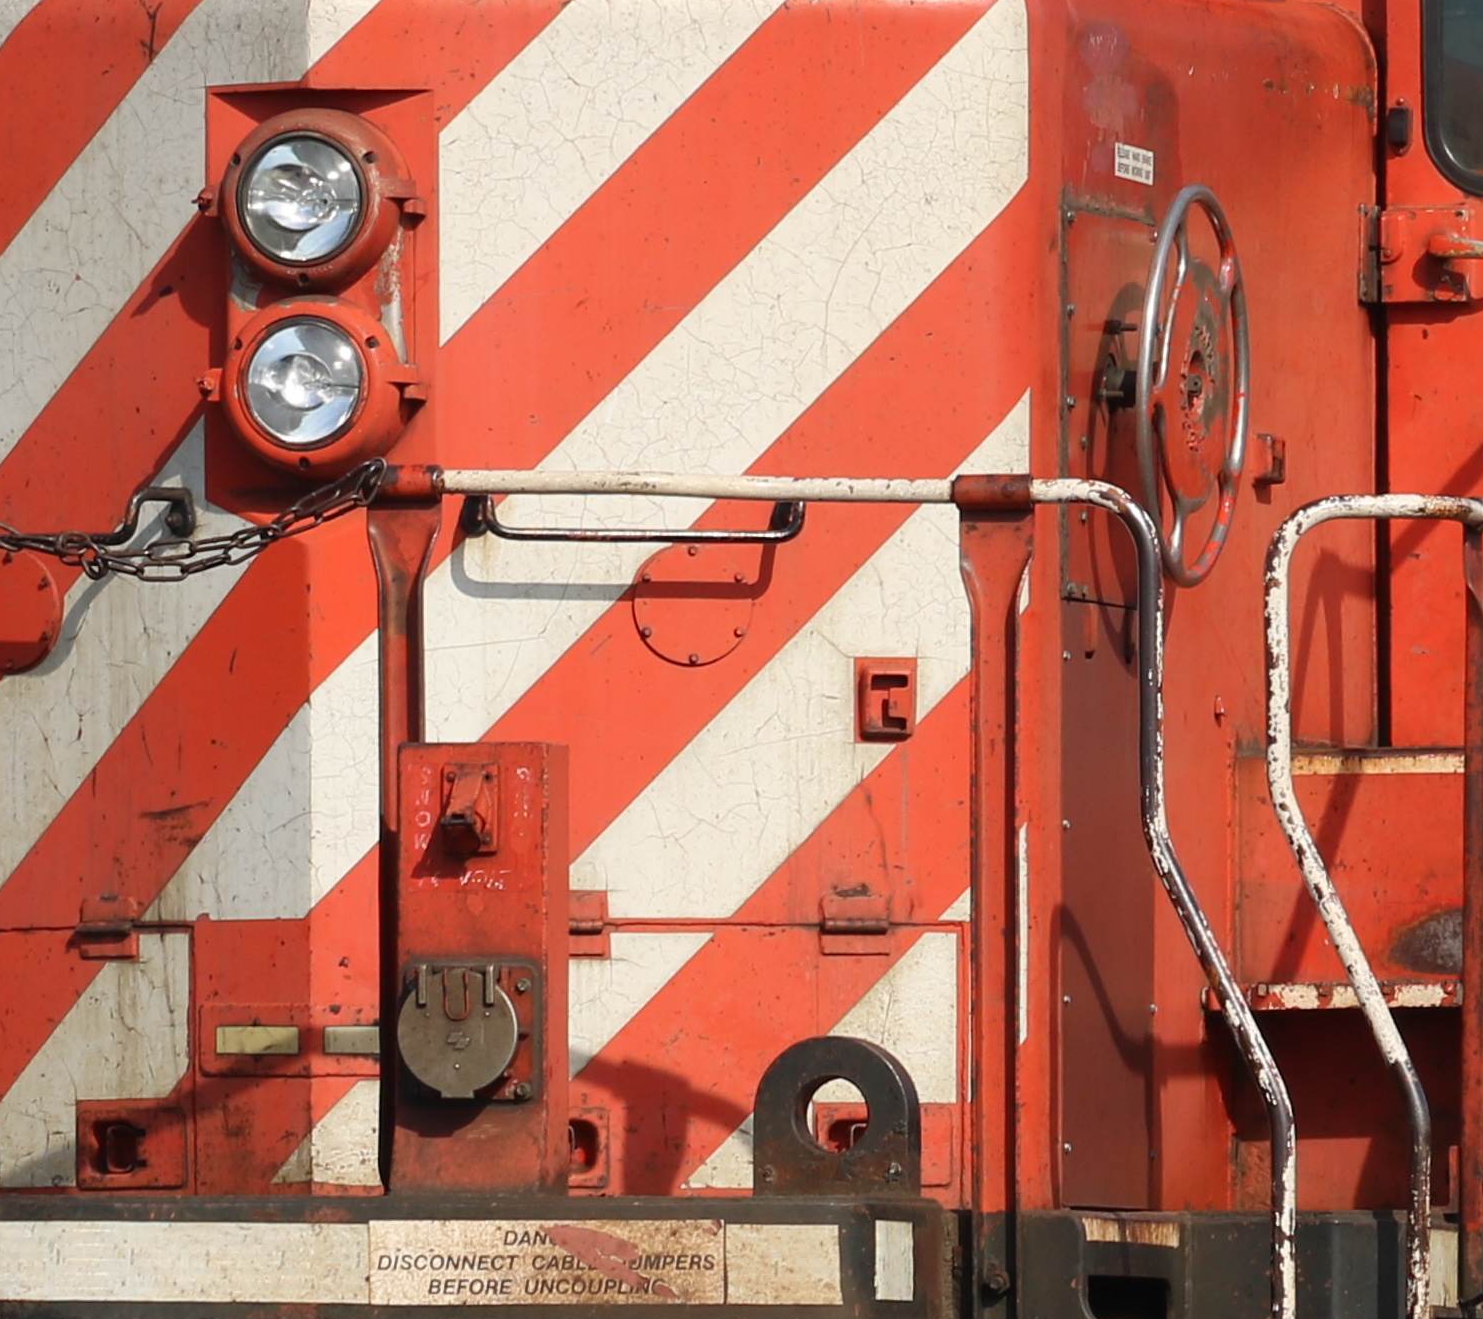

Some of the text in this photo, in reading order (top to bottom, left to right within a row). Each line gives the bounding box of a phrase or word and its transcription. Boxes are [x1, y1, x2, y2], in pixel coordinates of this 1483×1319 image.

[376, 1254, 521, 1272] DISCONNECT
[623, 1254, 716, 1272] UMPERS
[427, 1278, 513, 1296] BEFORE
